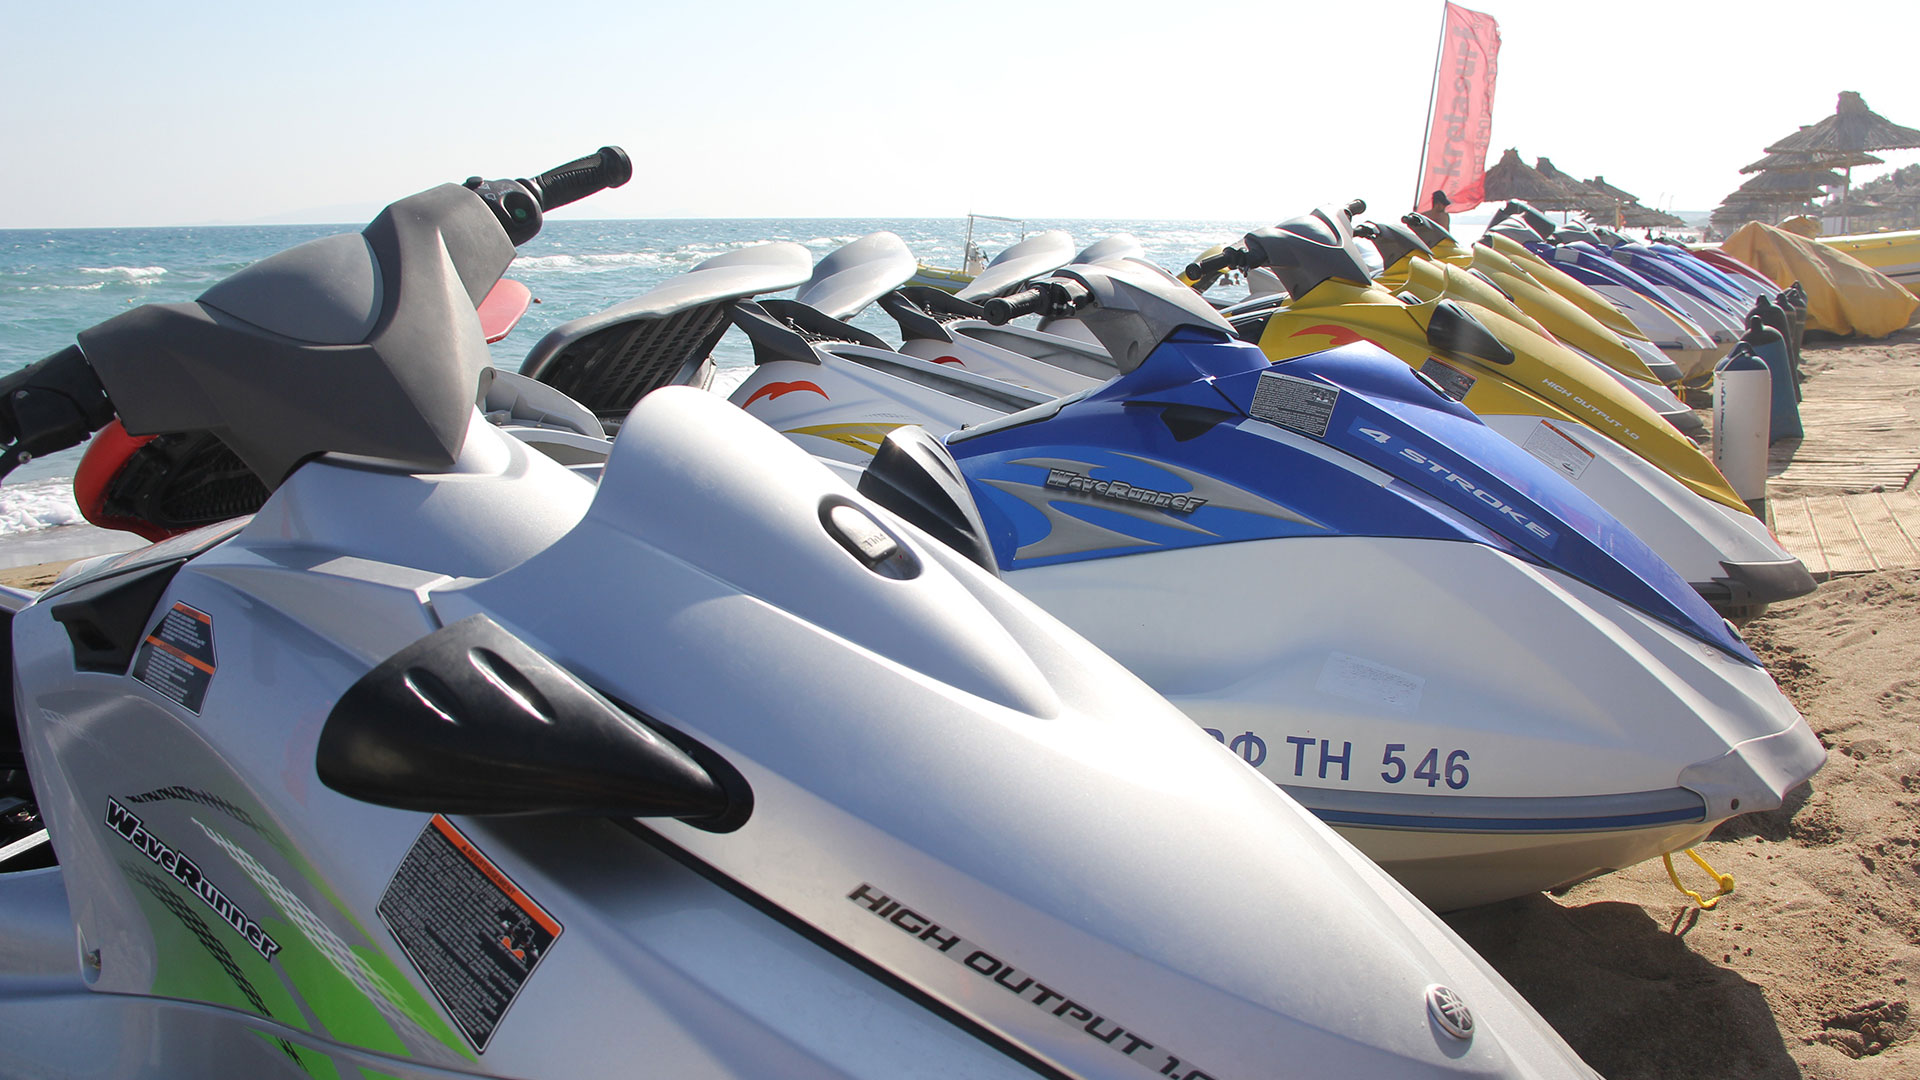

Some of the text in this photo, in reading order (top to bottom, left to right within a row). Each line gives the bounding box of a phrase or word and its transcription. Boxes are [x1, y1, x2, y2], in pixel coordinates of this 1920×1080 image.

[1432, 26, 1479, 177] kretasurf
[1542, 378, 1640, 440] HIGH OUTPUT 1.0
[1044, 468, 1208, 514] WaveRunner
[1358, 427, 1391, 443] 4
[1400, 448, 1550, 539] STROKE
[1381, 743, 1470, 789] 546
[105, 796, 282, 962] WaveRunner
[849, 884, 961, 952] HIGH
[963, 950, 1154, 1055] OUTPUT
